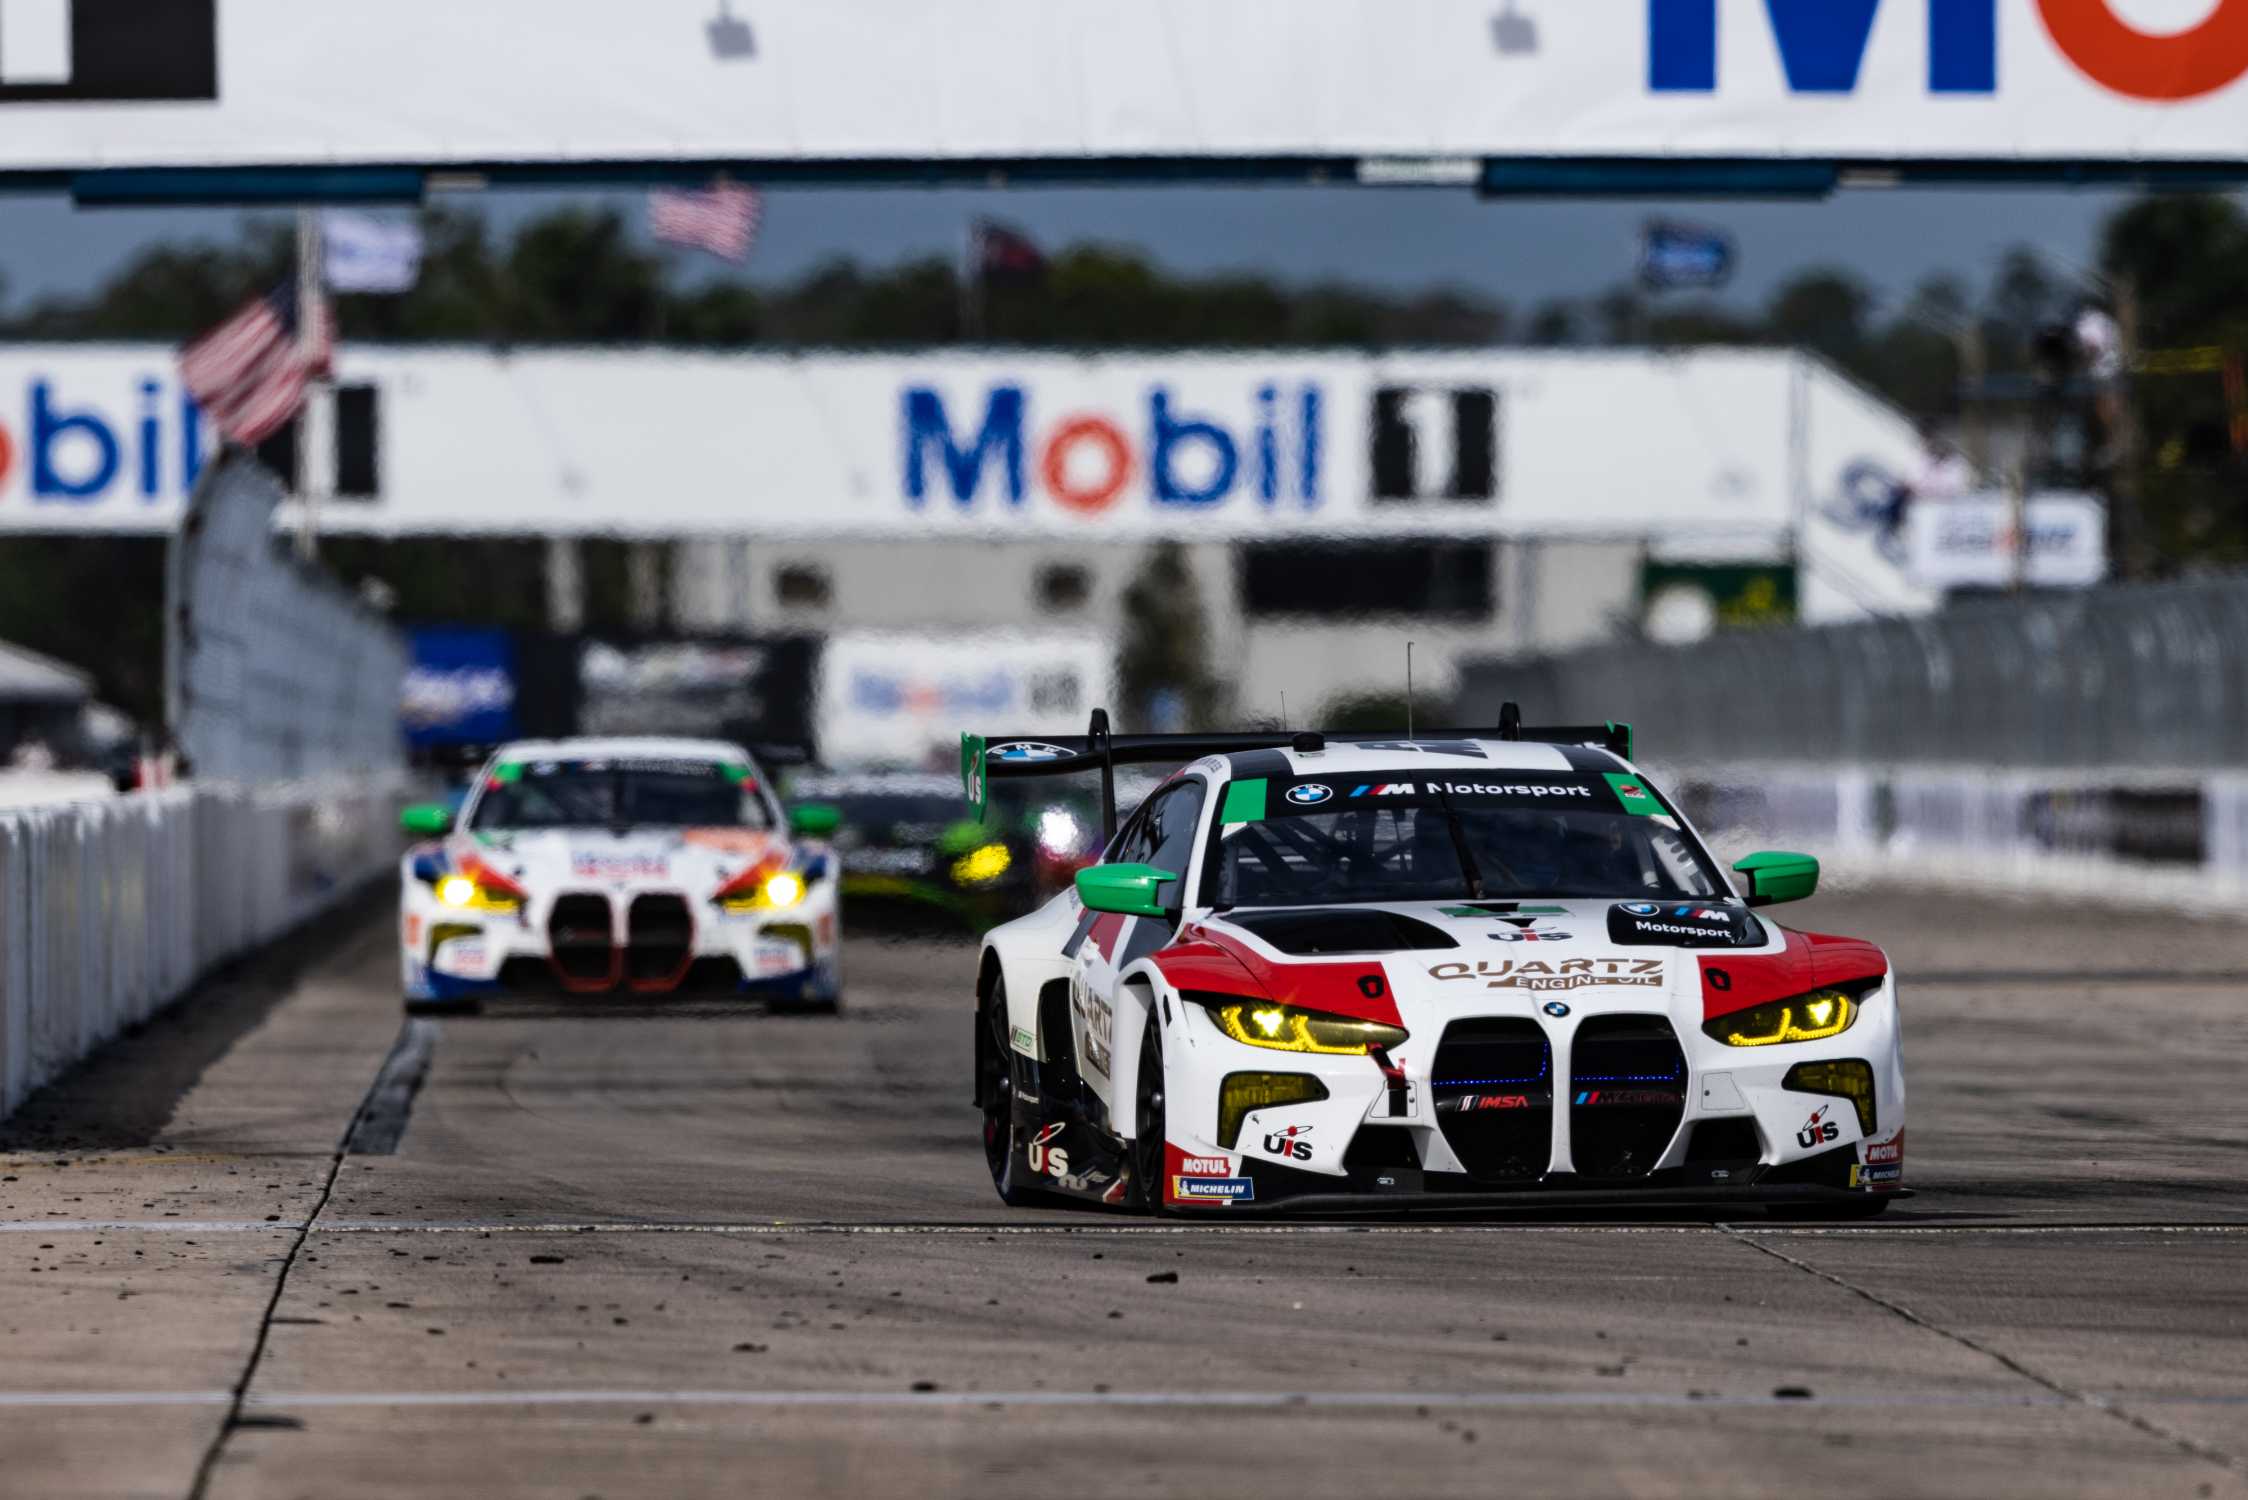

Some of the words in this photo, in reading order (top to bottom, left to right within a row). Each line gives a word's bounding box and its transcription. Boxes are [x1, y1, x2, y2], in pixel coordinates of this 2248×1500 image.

[0, 380, 203, 498] bil
[898, 382, 1322, 512] Mobil
[1426, 782, 1591, 797] Motorsport
[1635, 920, 1732, 938] Motorsport
[1428, 958, 1664, 980] QUARTZ
[1479, 1096, 1530, 1109] IMSA
[1182, 1158, 1227, 1174] MOTUL
[1190, 1184, 1245, 1194] MICHELIN
